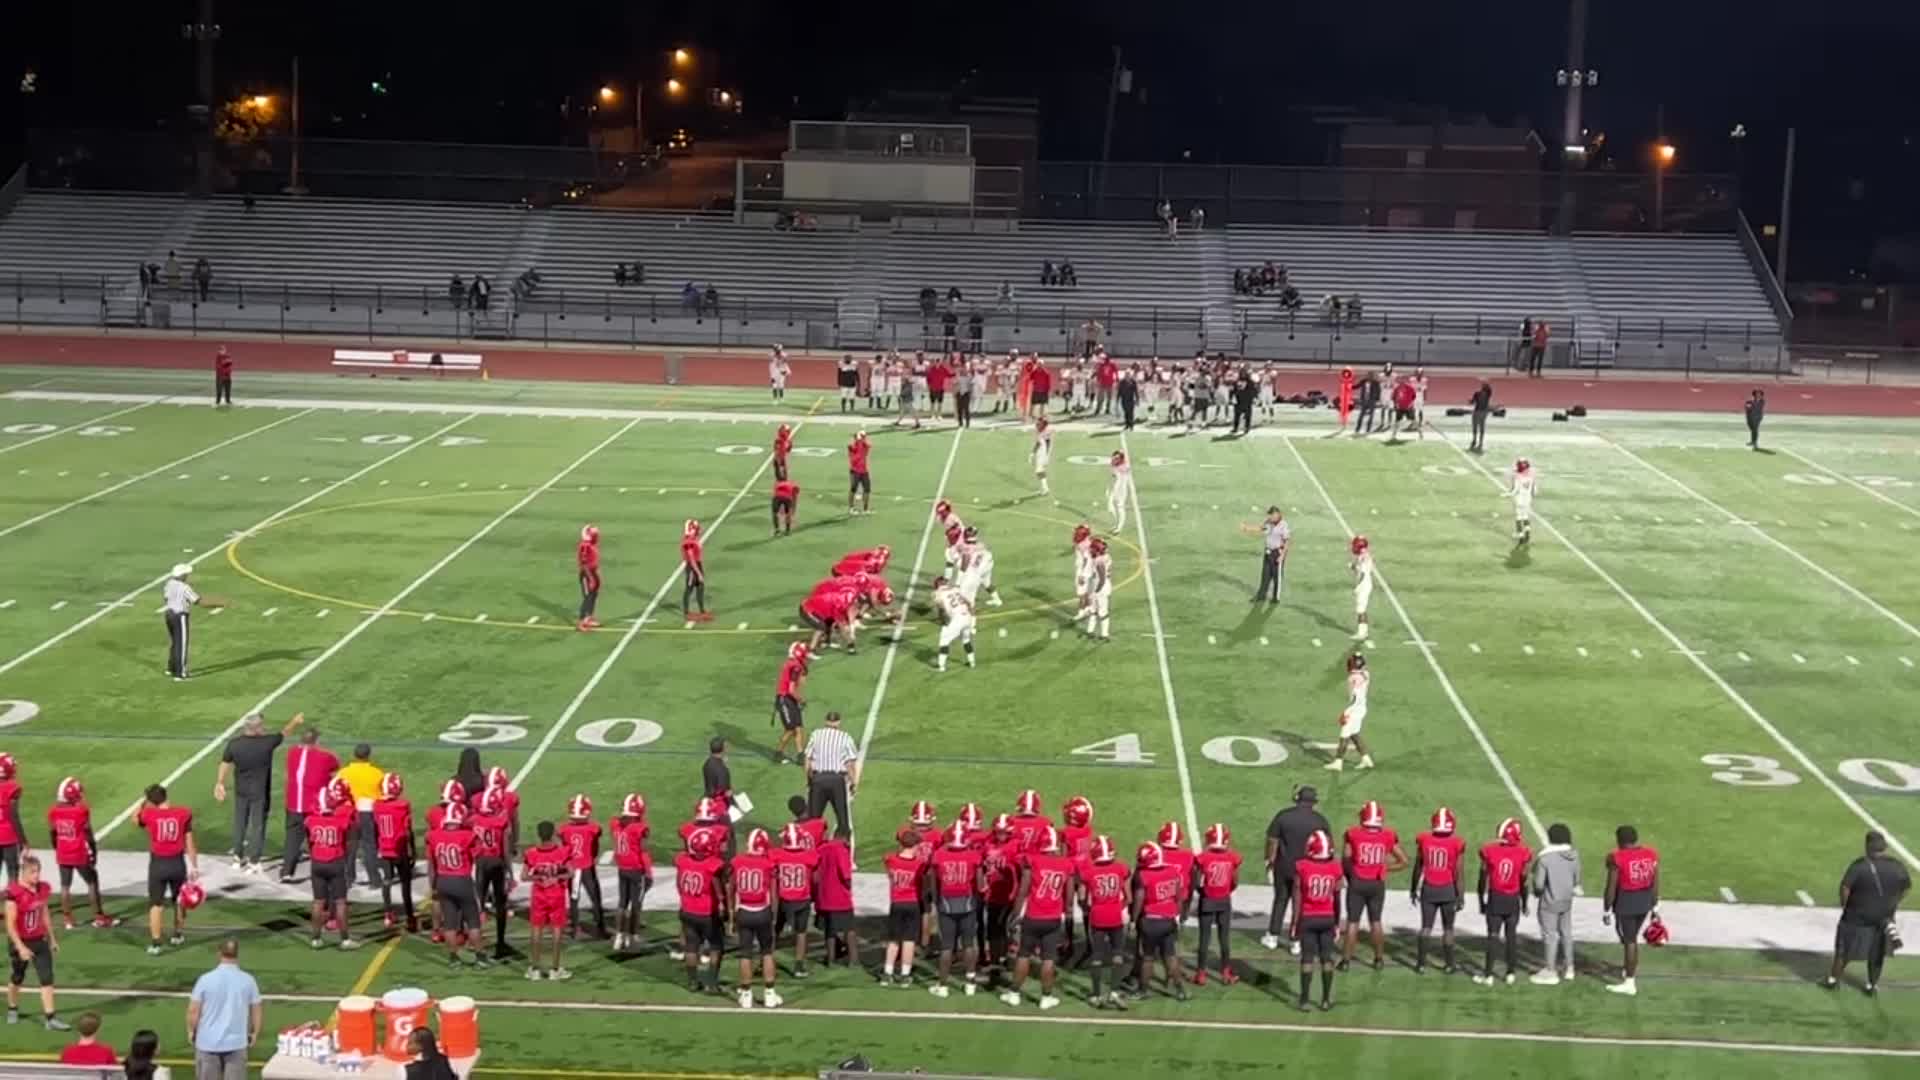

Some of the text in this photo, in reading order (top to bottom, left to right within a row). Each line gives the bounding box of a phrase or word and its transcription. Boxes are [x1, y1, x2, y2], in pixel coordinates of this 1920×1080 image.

[439, 714, 663, 747] 50
[1071, 733, 1289, 766] 40
[1701, 754, 1920, 791] 30
[157, 818, 178, 841] 19
[1036, 870, 1065, 898] 79
[394, 1015, 415, 1036] G
